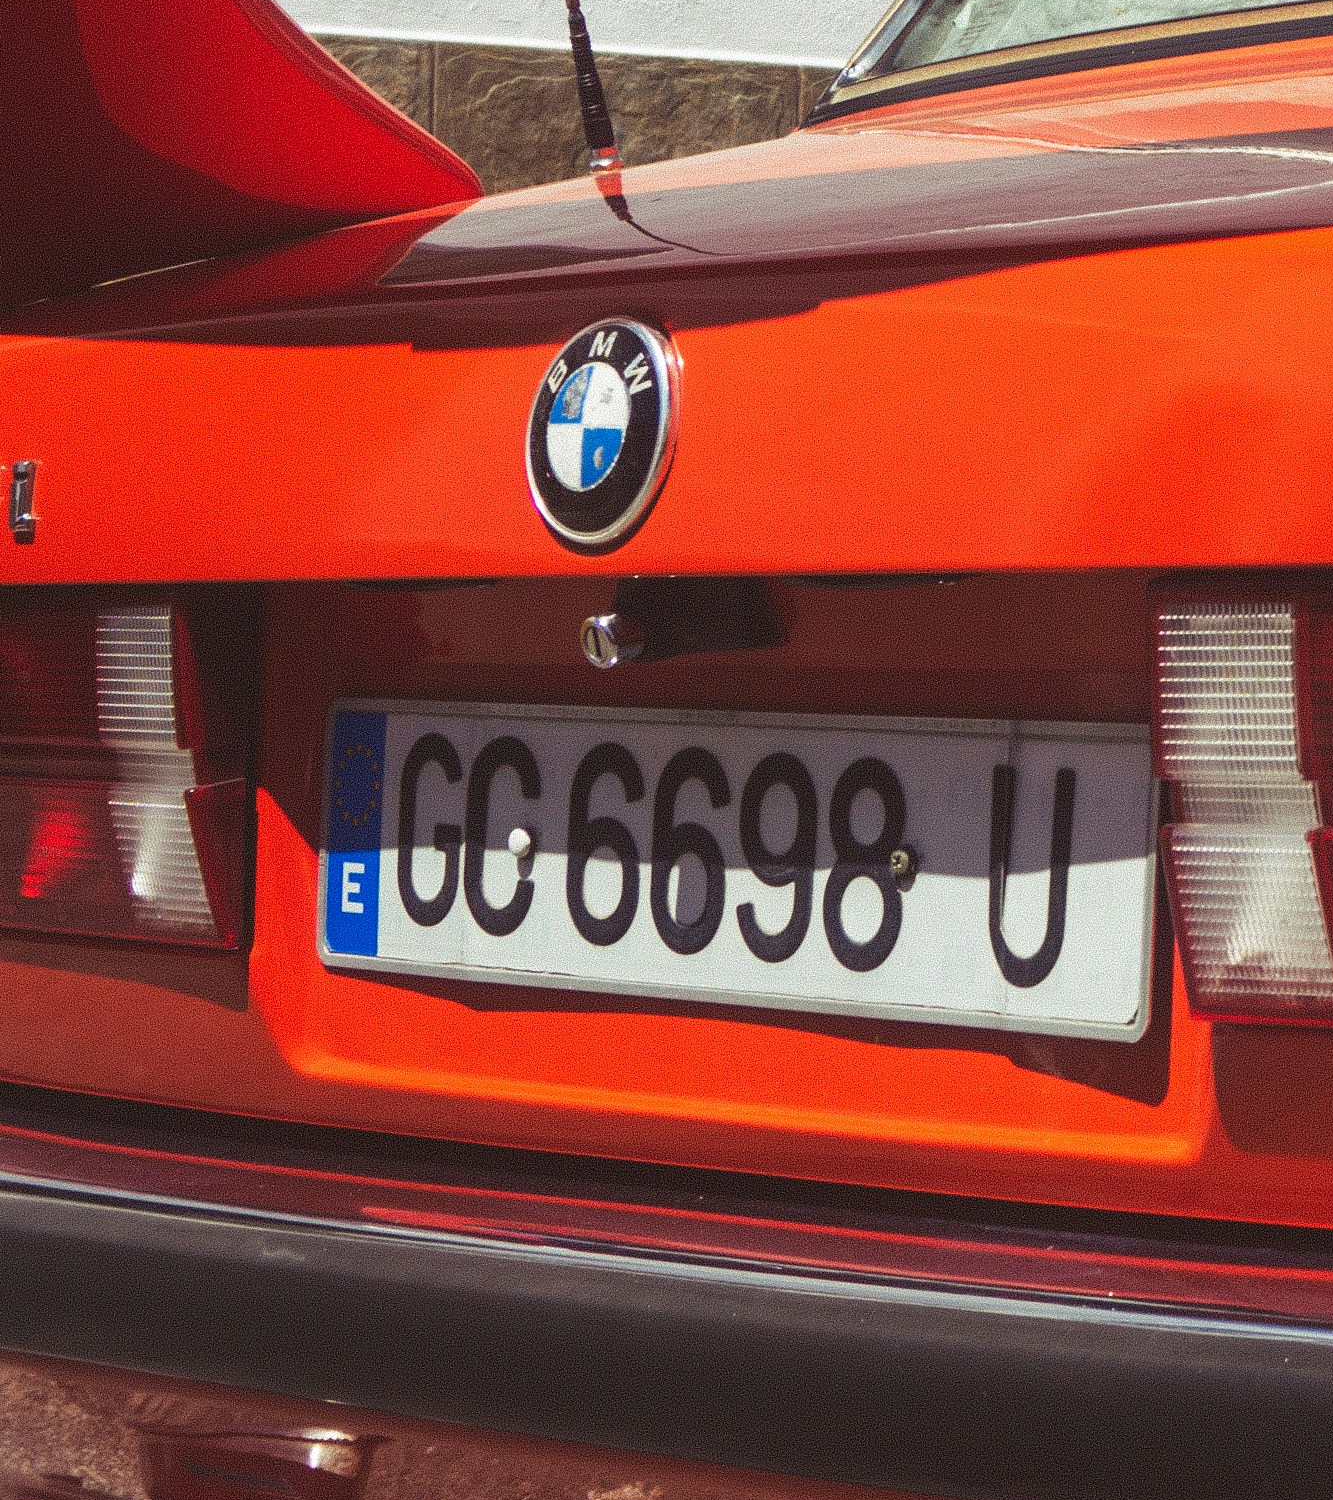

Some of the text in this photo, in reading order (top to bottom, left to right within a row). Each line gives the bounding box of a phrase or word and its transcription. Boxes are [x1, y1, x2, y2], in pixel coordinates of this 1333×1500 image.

[547, 330, 653, 395] BMW
[340, 861, 367, 915] E
[397, 731, 1077, 989] GC 6698 U
